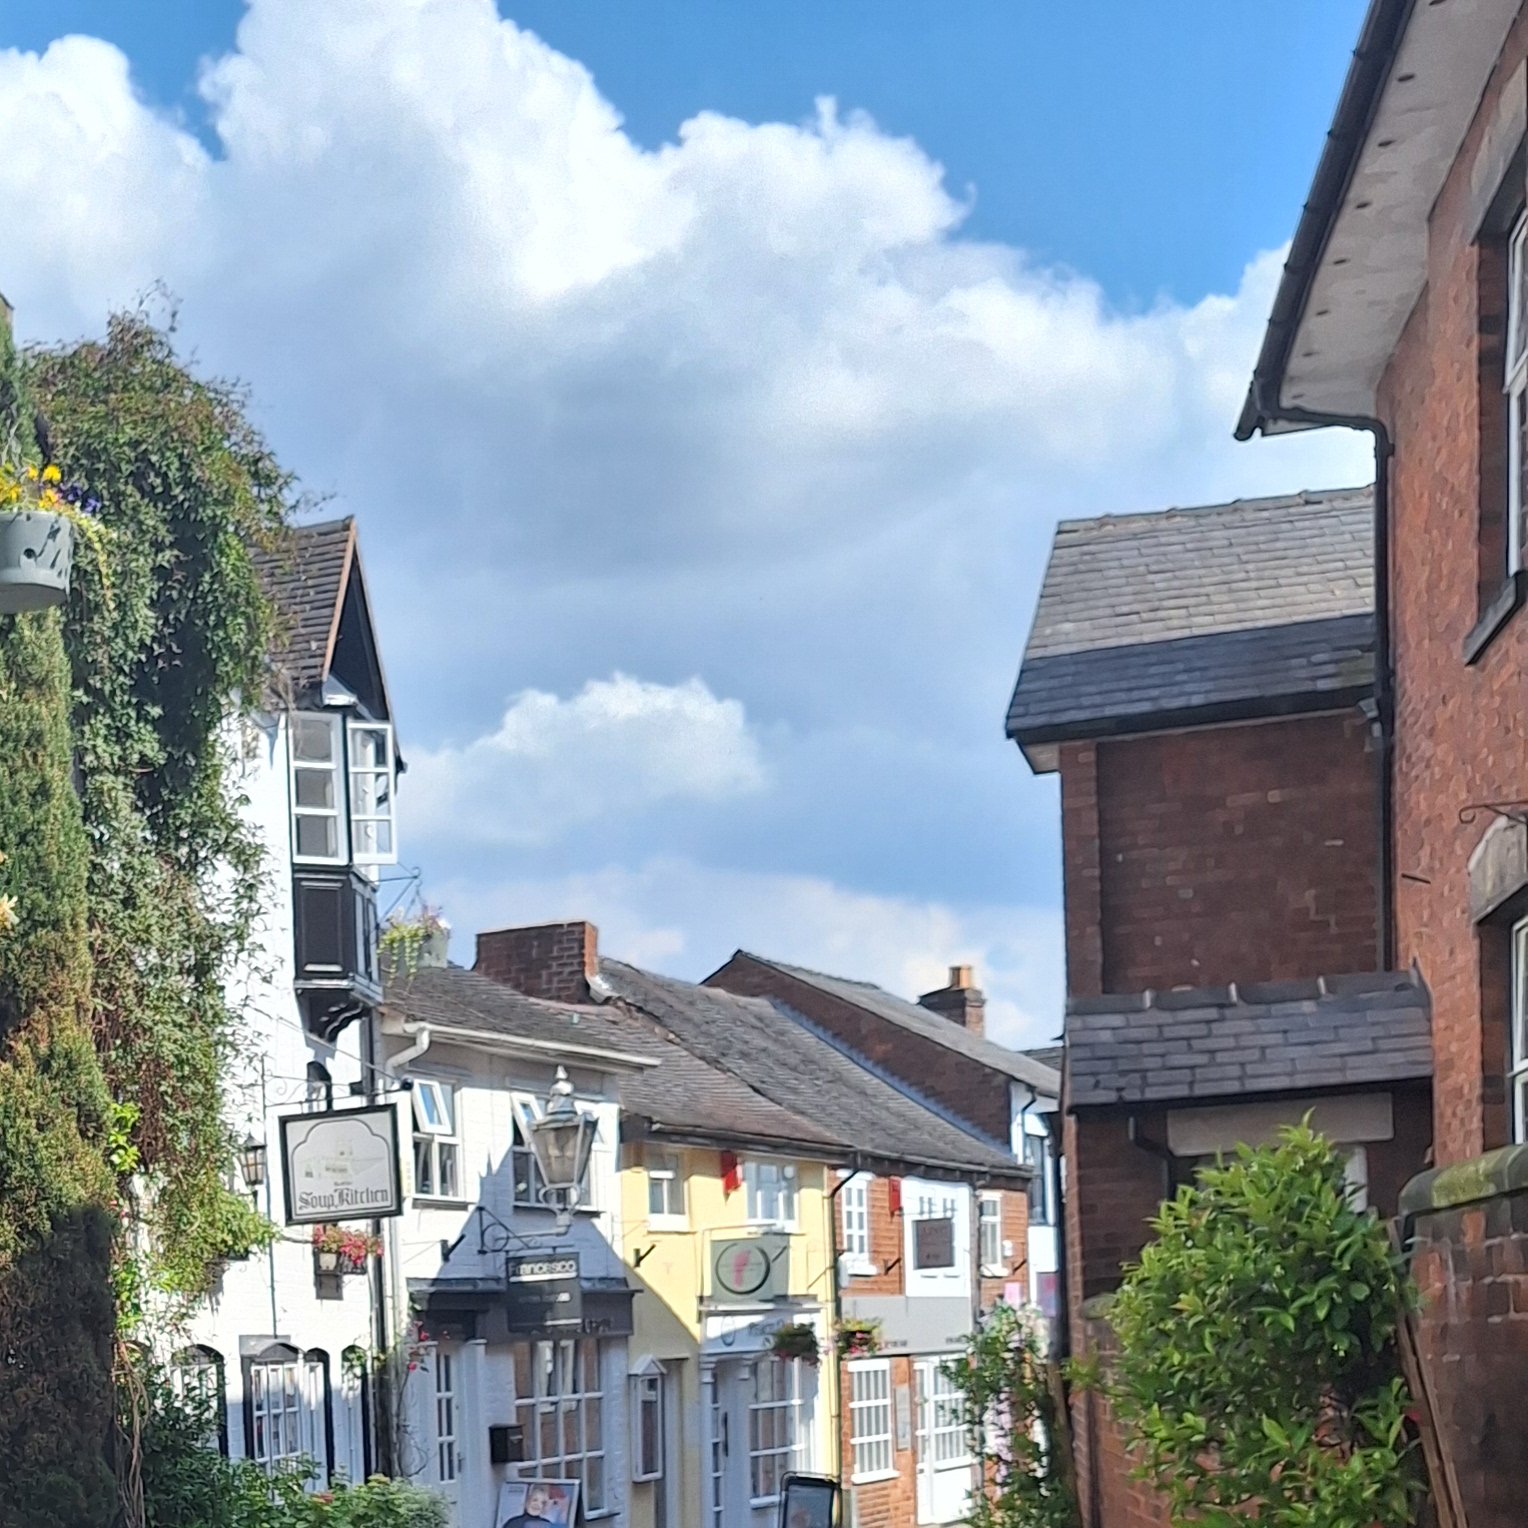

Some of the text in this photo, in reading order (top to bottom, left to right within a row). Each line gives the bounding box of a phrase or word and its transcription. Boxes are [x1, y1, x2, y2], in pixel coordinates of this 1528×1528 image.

[298, 1187, 389, 1210] Soup Kitchen
[508, 1260, 577, 1277] Francesco
